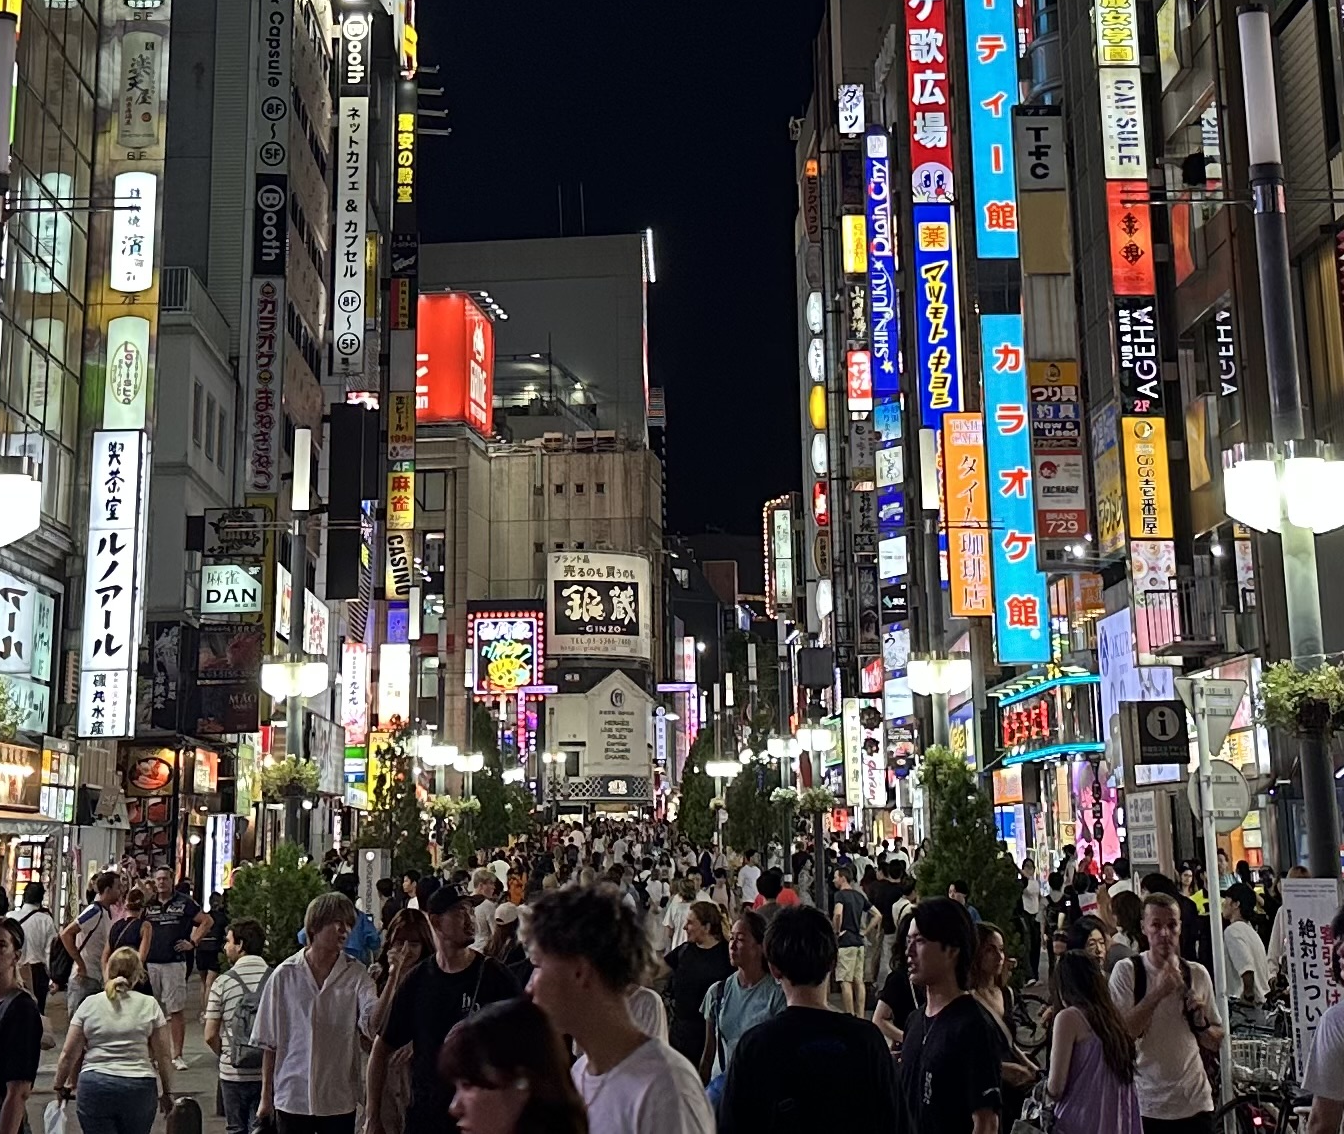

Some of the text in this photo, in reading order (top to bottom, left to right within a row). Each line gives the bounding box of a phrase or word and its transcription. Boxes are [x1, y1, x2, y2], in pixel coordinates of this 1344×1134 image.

[266, 11, 285, 89] Capsule
[343, 17, 368, 84] Booth
[842, 88, 859, 128] ダーツ
[346, 107, 361, 191] ネットカフェ
[258, 186, 285, 261] Booth
[343, 220, 359, 278] カプセル
[922, 226, 945, 248] 薬
[258, 298, 278, 365] カラオケ
[921, 260, 952, 409] マツモトキヨシ
[1132, 306, 1159, 398] AGEHA
[1032, 386, 1078, 402] つり具
[1134, 400, 1150, 412] 2F
[104, 441, 125, 522] 喫茶室
[391, 475, 410, 512] 麻雀
[995, 345, 1040, 629] カラオケ館
[960, 455, 988, 610] タイム珈琲店
[1047, 520, 1078, 534] 729
[92, 532, 126, 658] ルノアール
[206, 588, 257, 604] DAN
